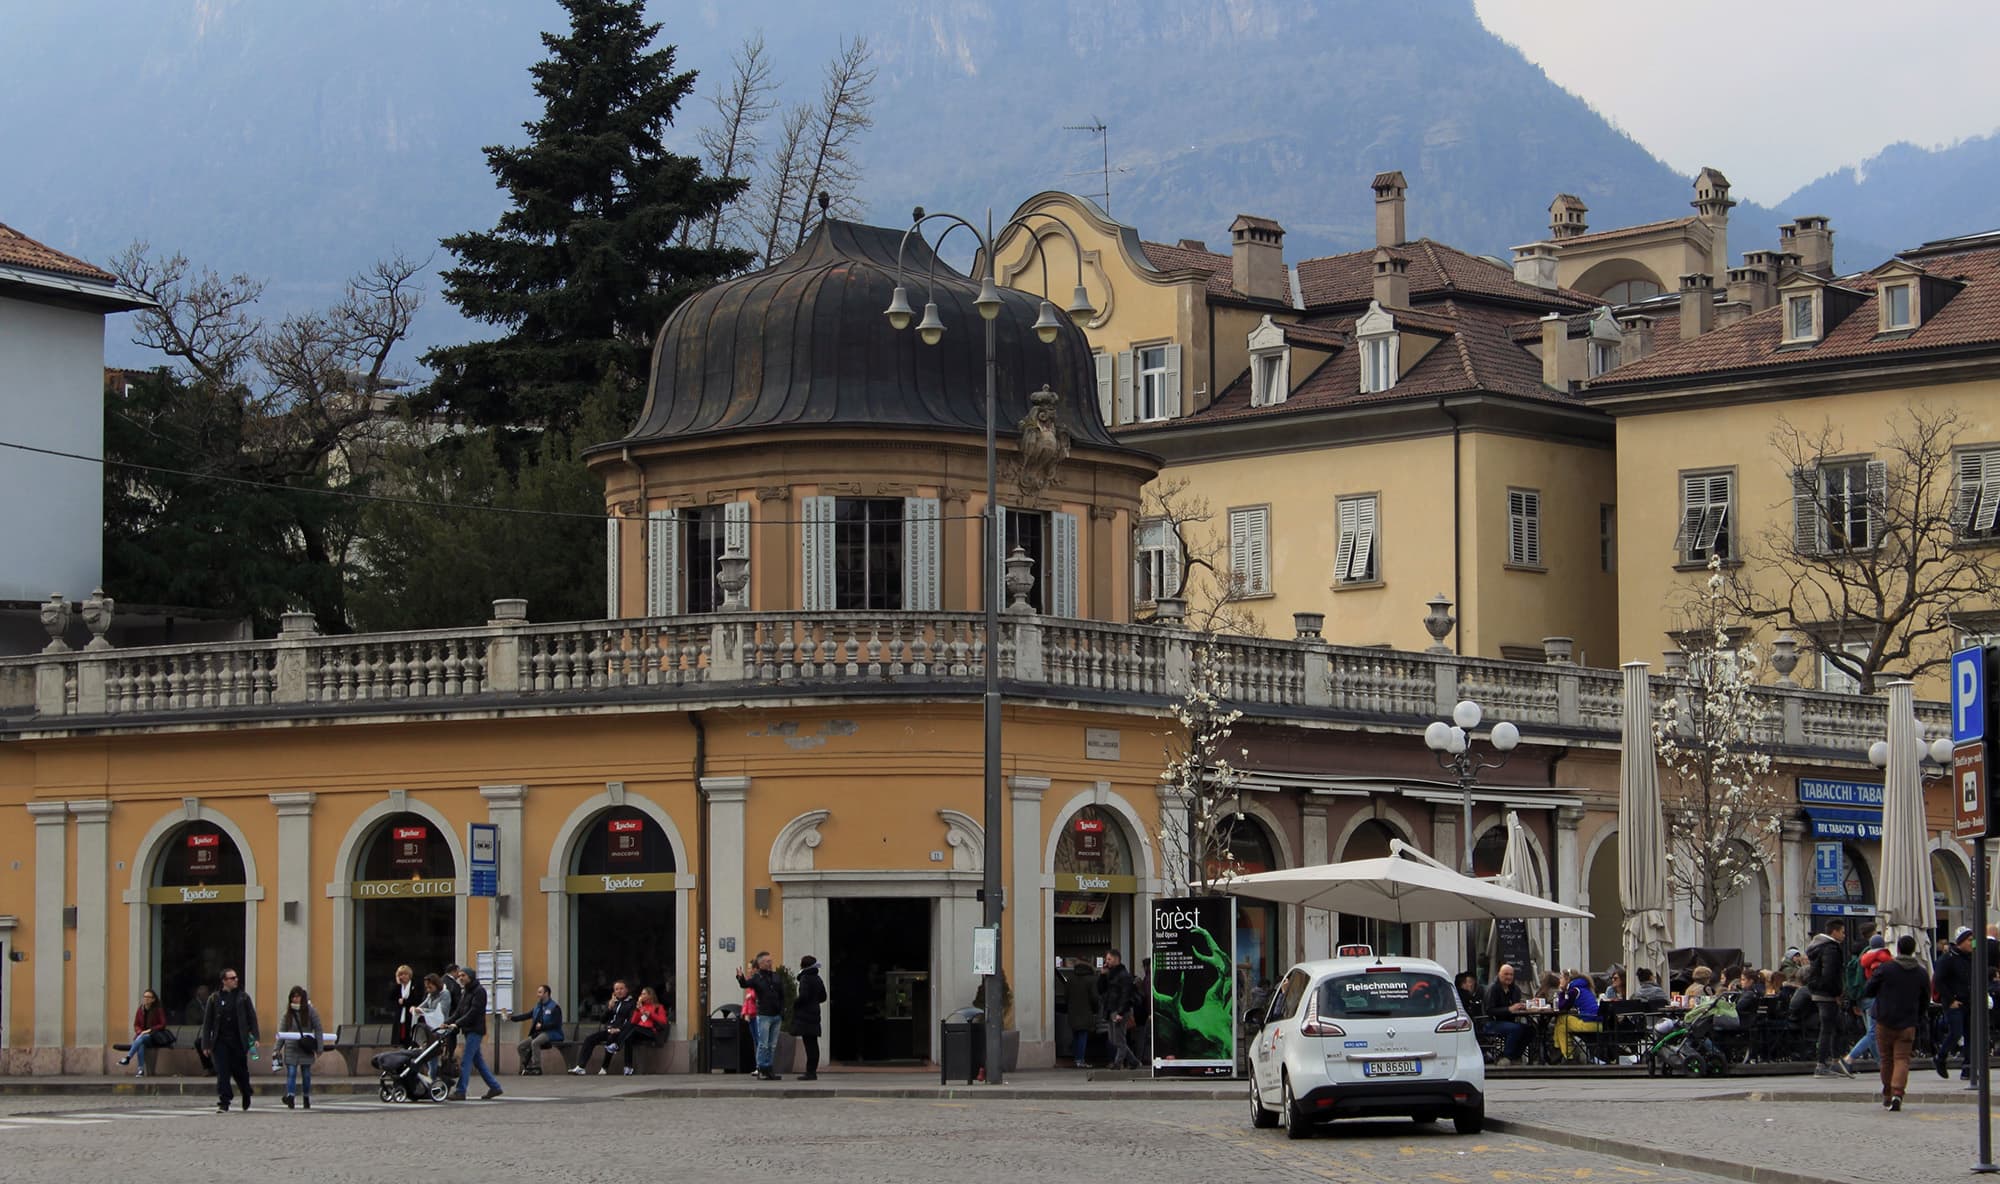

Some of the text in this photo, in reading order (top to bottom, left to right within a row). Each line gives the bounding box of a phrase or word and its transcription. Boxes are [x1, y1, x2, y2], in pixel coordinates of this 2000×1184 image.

[1958, 660, 1977, 731] P
[1803, 783, 1885, 803] TABACCHI TABA
[1829, 823, 1855, 835] TABACCHI
[601, 876, 644, 891] Loacker
[1075, 874, 1110, 890] Loacker
[180, 887, 219, 904] Loacker
[1155, 906, 1200, 930] Forèst
[1342, 947, 1369, 956] TAXI
[1345, 982, 1407, 991] Fleischmann
[1370, 1060, 1415, 1073] EN 865DL
